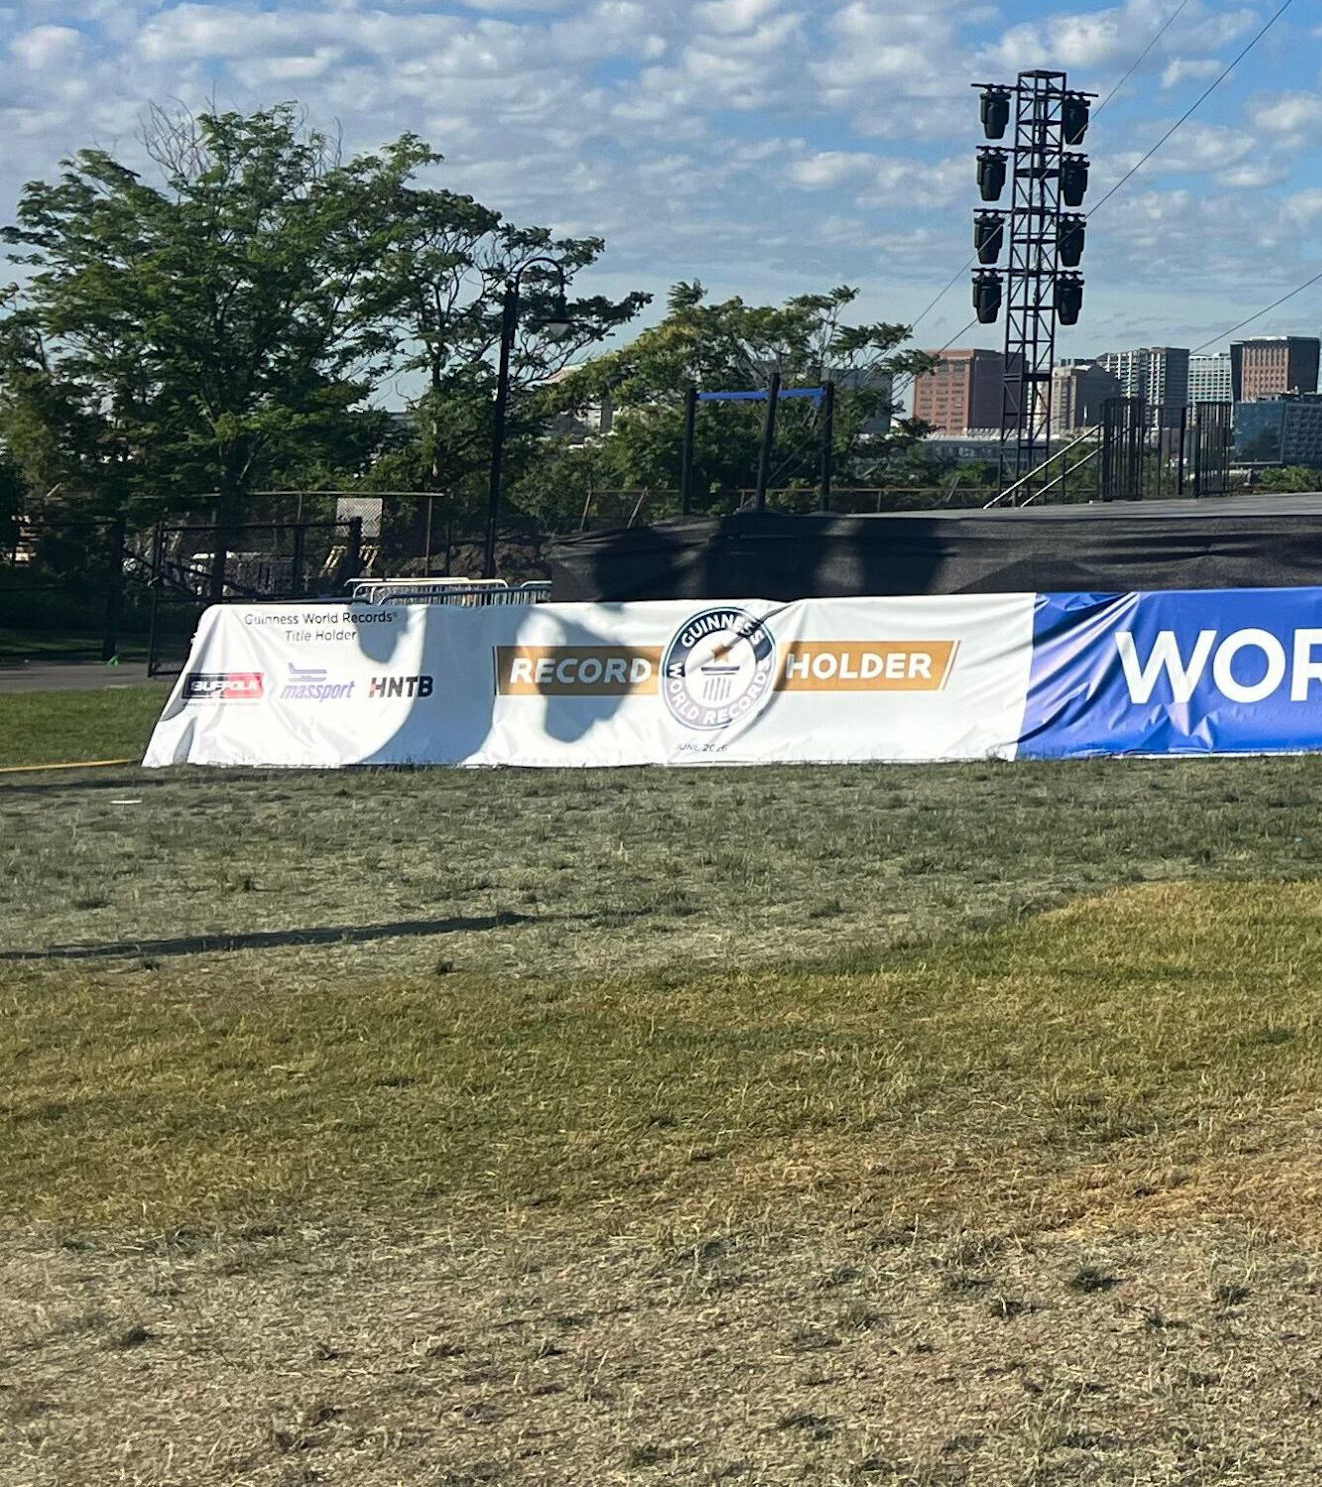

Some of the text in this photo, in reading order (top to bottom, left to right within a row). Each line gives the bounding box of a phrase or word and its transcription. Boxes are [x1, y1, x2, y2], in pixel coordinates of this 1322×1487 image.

[243, 613, 300, 625] Guinness
[302, 612, 339, 624] World
[680, 613, 765, 649] GUINNESS
[284, 629, 357, 642] Title Holder
[509, 656, 653, 685] RECORD
[786, 651, 933, 681] HOLDER
[279, 682, 356, 703] massport
[368, 675, 434, 699] HNTB
[668, 658, 771, 725] WORLD RECORDS
